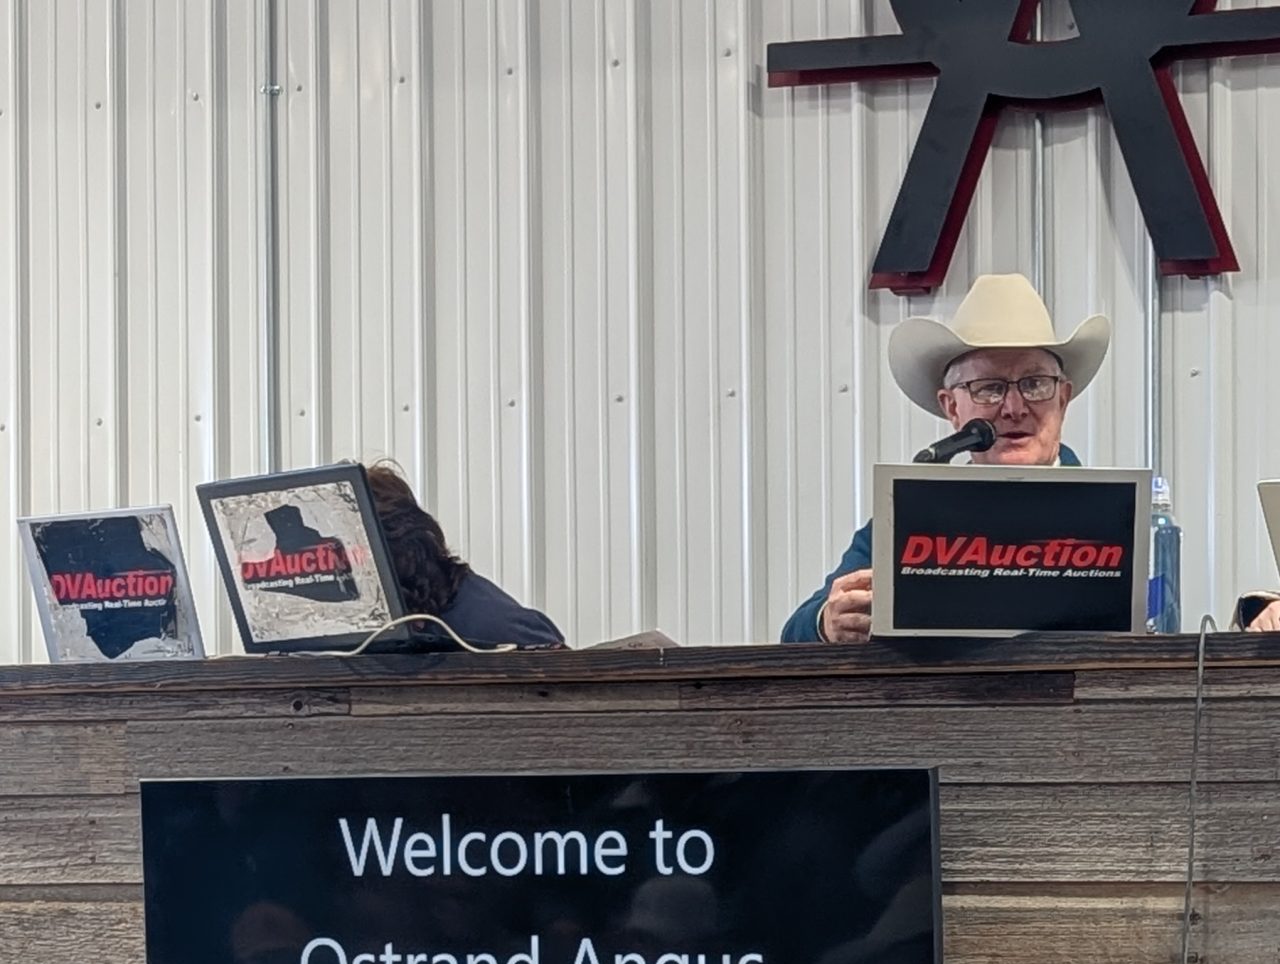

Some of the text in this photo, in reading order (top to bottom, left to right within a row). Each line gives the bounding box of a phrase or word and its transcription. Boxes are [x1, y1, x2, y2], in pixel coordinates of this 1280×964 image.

[901, 535, 1123, 567] DVAuction
[901, 566, 1121, 577] Broadcasting Real-Time Auctions
[338, 813, 715, 877] Welcome to
